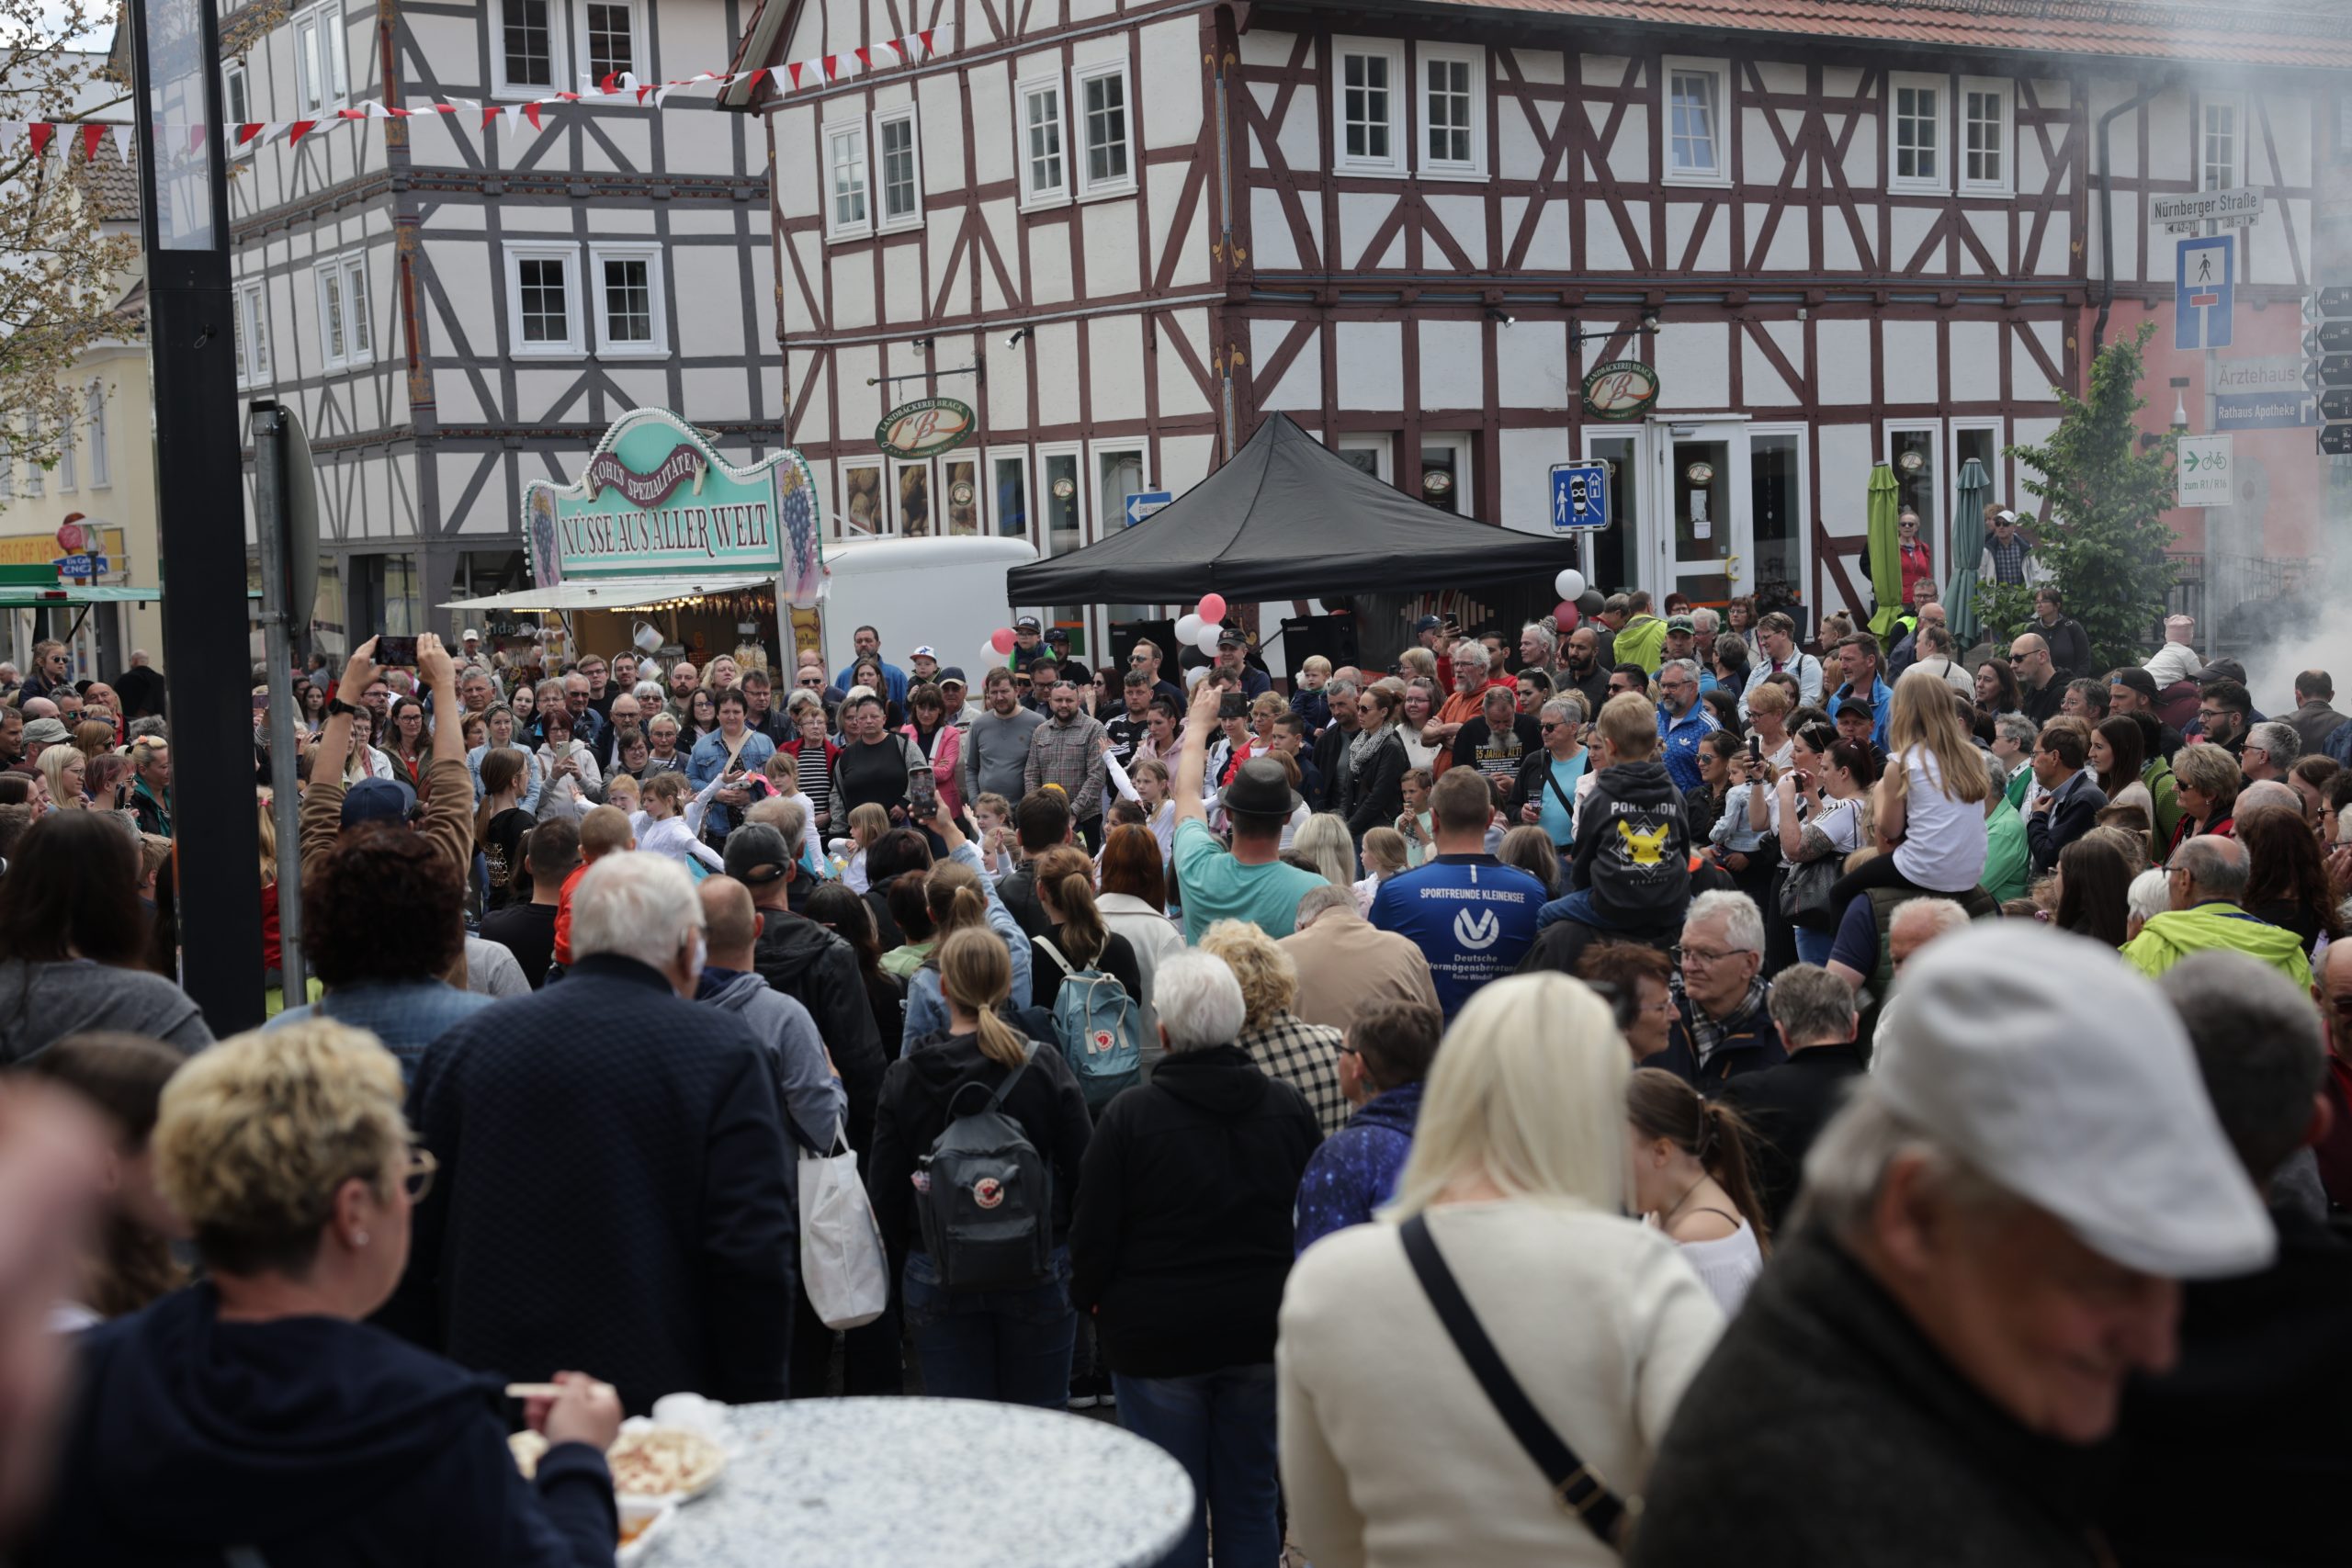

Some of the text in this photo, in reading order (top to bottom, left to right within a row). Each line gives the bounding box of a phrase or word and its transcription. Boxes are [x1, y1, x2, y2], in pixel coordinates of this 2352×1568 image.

[2154, 192, 2257, 219] Nürnberger Straße
[2177, 221, 2196, 233] 42-71
[2226, 218, 2234, 228] 38
[1586, 362, 1654, 387] LANDBÄCKEREI BRACK
[2219, 365, 2296, 386] Ärztehaus
[879, 400, 965, 433] LANDBÄCKEREI BRACK
[2219, 403, 2296, 420] Rathaus Apotheke
[592, 453, 701, 501] KOHL'S SPEZIALITÄTEN
[2184, 479, 2227, 491] zum R1/R16
[560, 503, 769, 558] NÜSSE AUS ALLER WELT
[1484, 748, 1506, 760] JAHRE
[1420, 887, 1525, 903] SPORTFREUNDE KLEINENSEE
[1454, 953, 1498, 963] Deutsche
